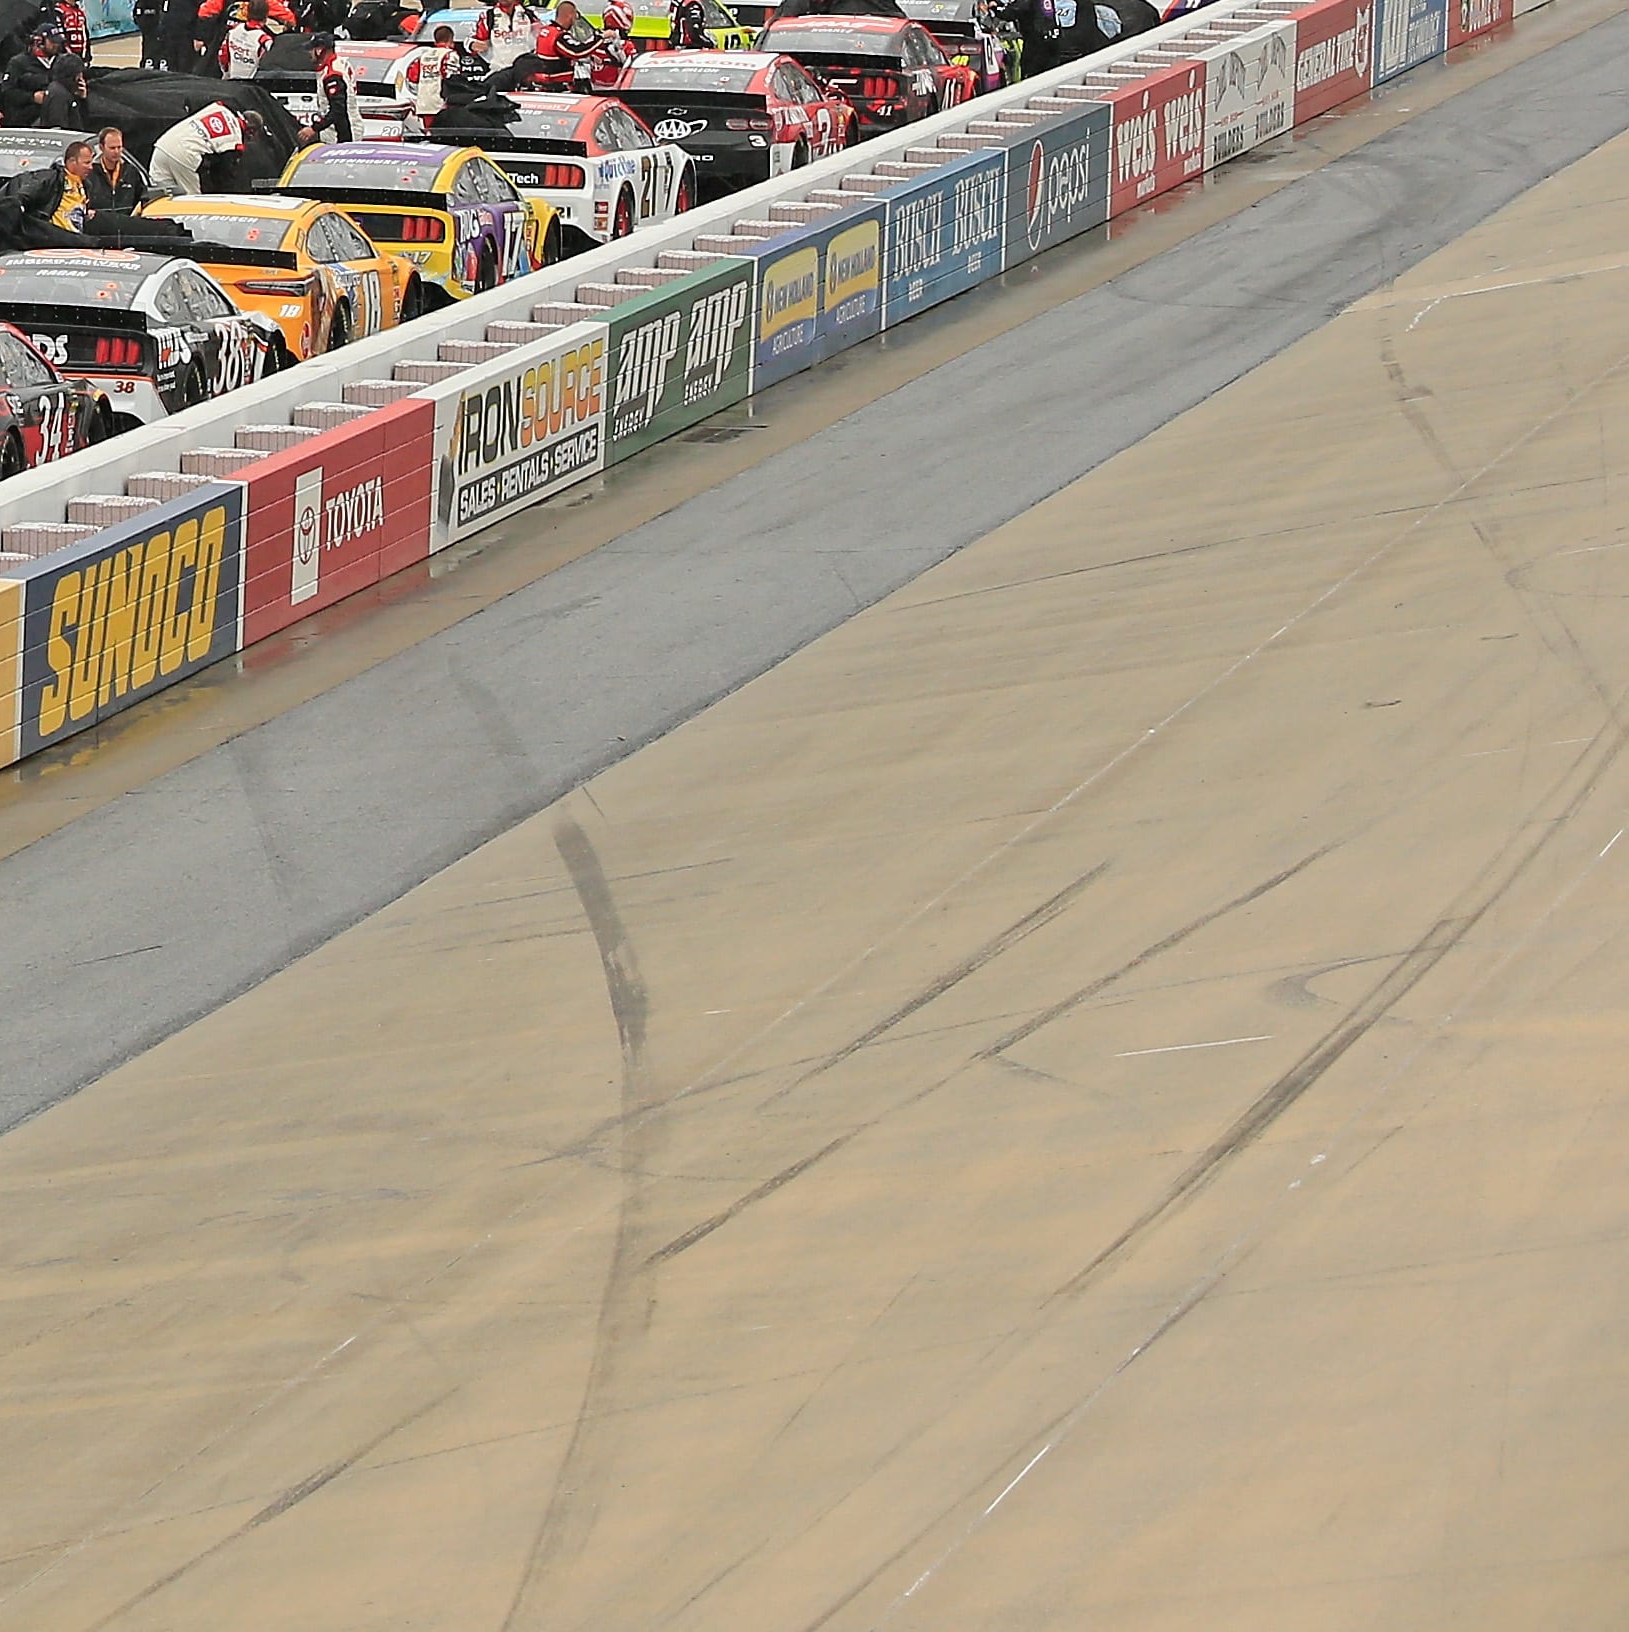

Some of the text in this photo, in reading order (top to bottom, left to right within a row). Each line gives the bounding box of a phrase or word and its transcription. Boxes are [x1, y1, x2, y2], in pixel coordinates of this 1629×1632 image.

[381, 126, 399, 138] 20
[655, 120, 691, 138] AAA
[749, 134, 768, 148] 3
[875, 104, 894, 117] 41
[1117, 89, 1158, 185] weis
[1164, 69, 1204, 162] weis
[952, 166, 1002, 257] BUSCH
[1047, 128, 1091, 235] pepsi
[215, 215, 259, 224] BUSCH
[502, 211, 526, 278] 17
[893, 191, 944, 283] BUSCH
[37, 268, 90, 278] RAGAN
[362, 272, 383, 336] 18
[278, 304, 301, 318] 18
[114, 380, 135, 394] 38
[213, 321, 240, 395] 38
[38, 391, 65, 467] 34
[325, 476, 385, 551] TOYOTA
[39, 505, 226, 739] SUNOCO
